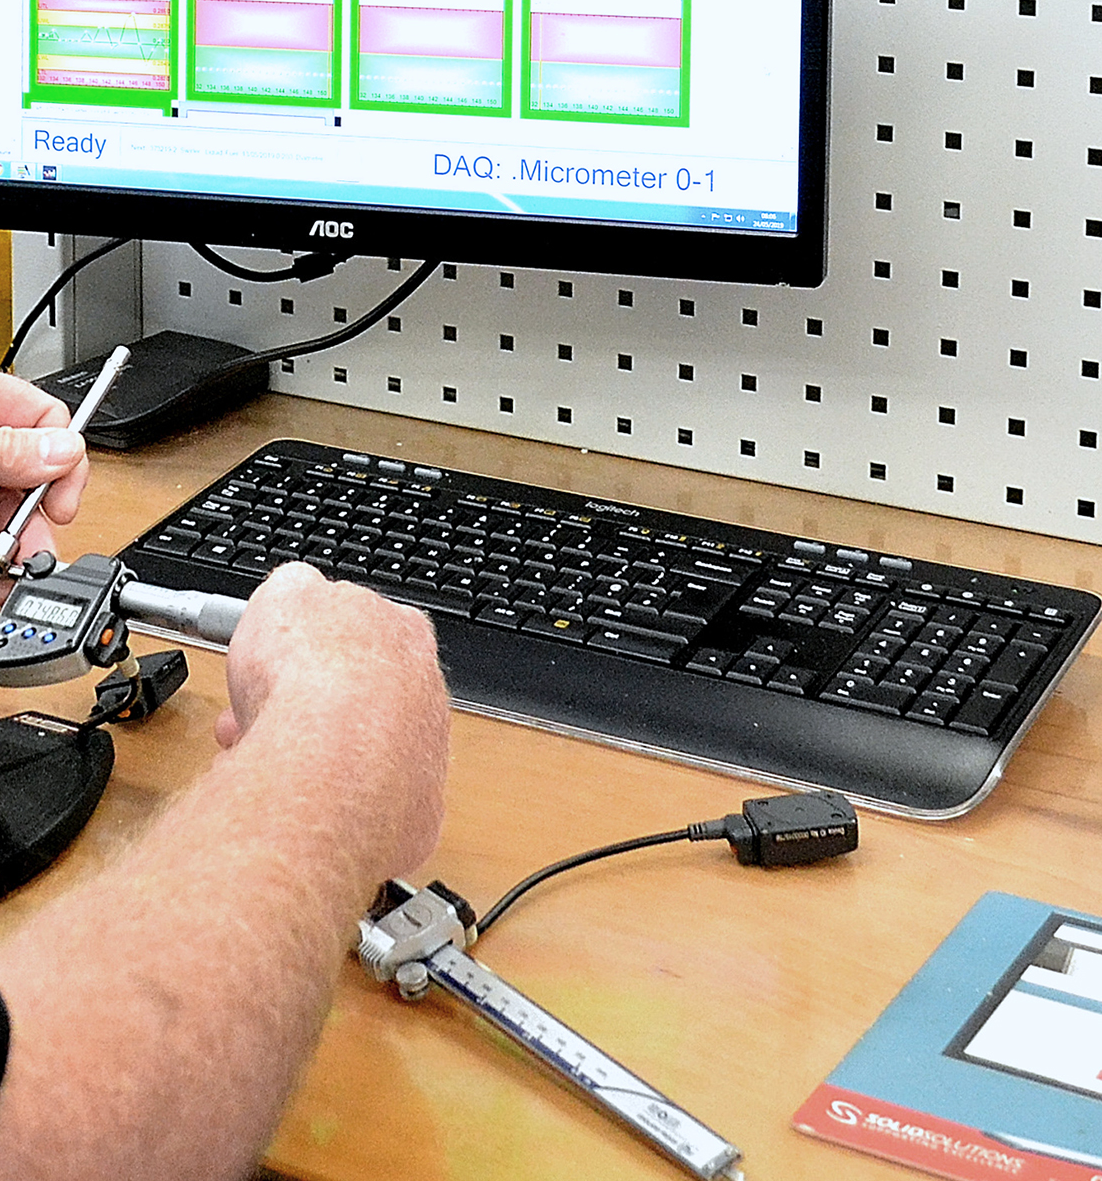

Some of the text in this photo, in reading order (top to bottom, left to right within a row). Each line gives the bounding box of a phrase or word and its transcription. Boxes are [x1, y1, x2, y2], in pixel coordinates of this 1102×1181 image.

[34, 129, 107, 159] Ready
[434, 154, 714, 192] DAQ: .Micrometer 0-1
[309, 220, 354, 239] AOC
[585, 501, 640, 517] logitech
[865, 1113, 1025, 1169] SOLIDSOLUTIONS
